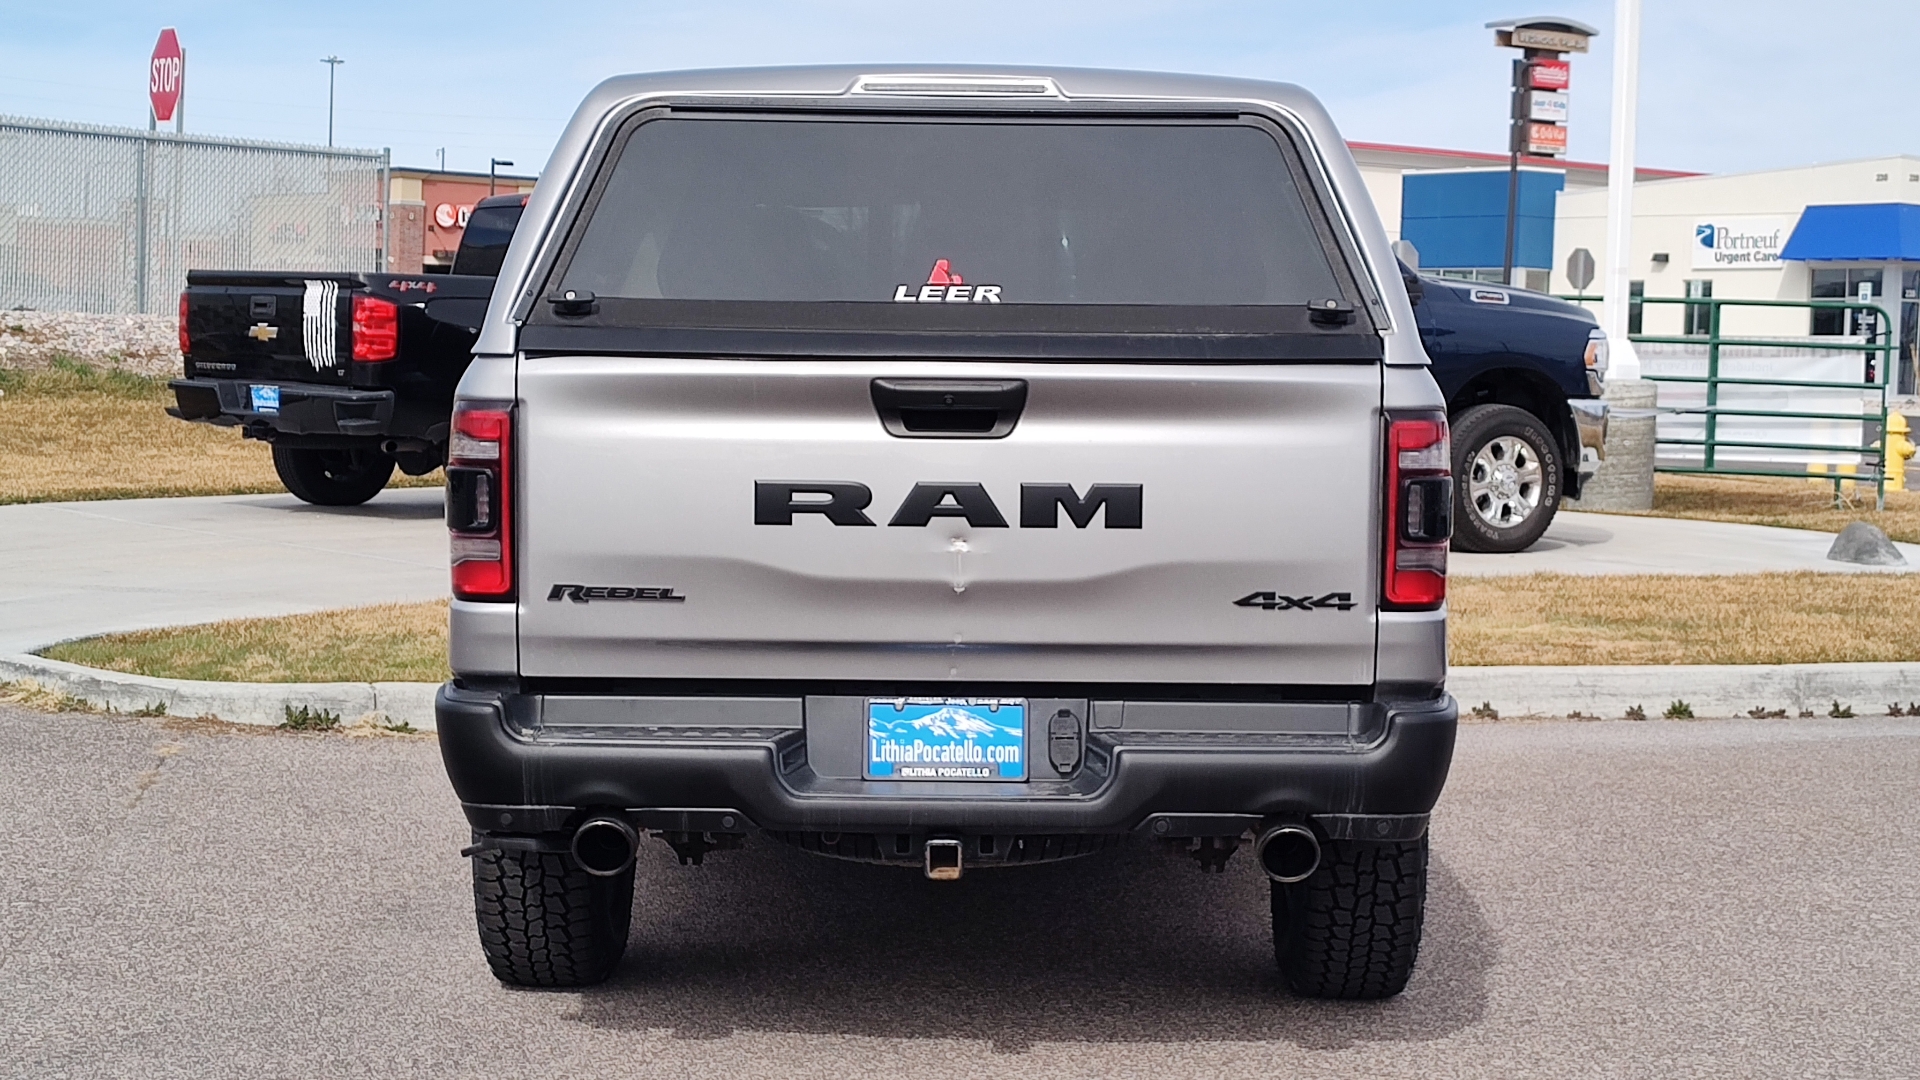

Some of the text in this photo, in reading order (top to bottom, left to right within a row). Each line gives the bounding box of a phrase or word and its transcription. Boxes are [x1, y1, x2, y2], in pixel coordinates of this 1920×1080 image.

[151, 57, 180, 93] STOP
[1716, 227, 1780, 250] Portneuf
[1714, 251, 1751, 264] Urgent
[893, 285, 1002, 303] LEER
[754, 479, 1143, 530] RAM
[871, 738, 1020, 763] LithiaPocatello.com
[938, 767, 990, 778] POCATELLO
